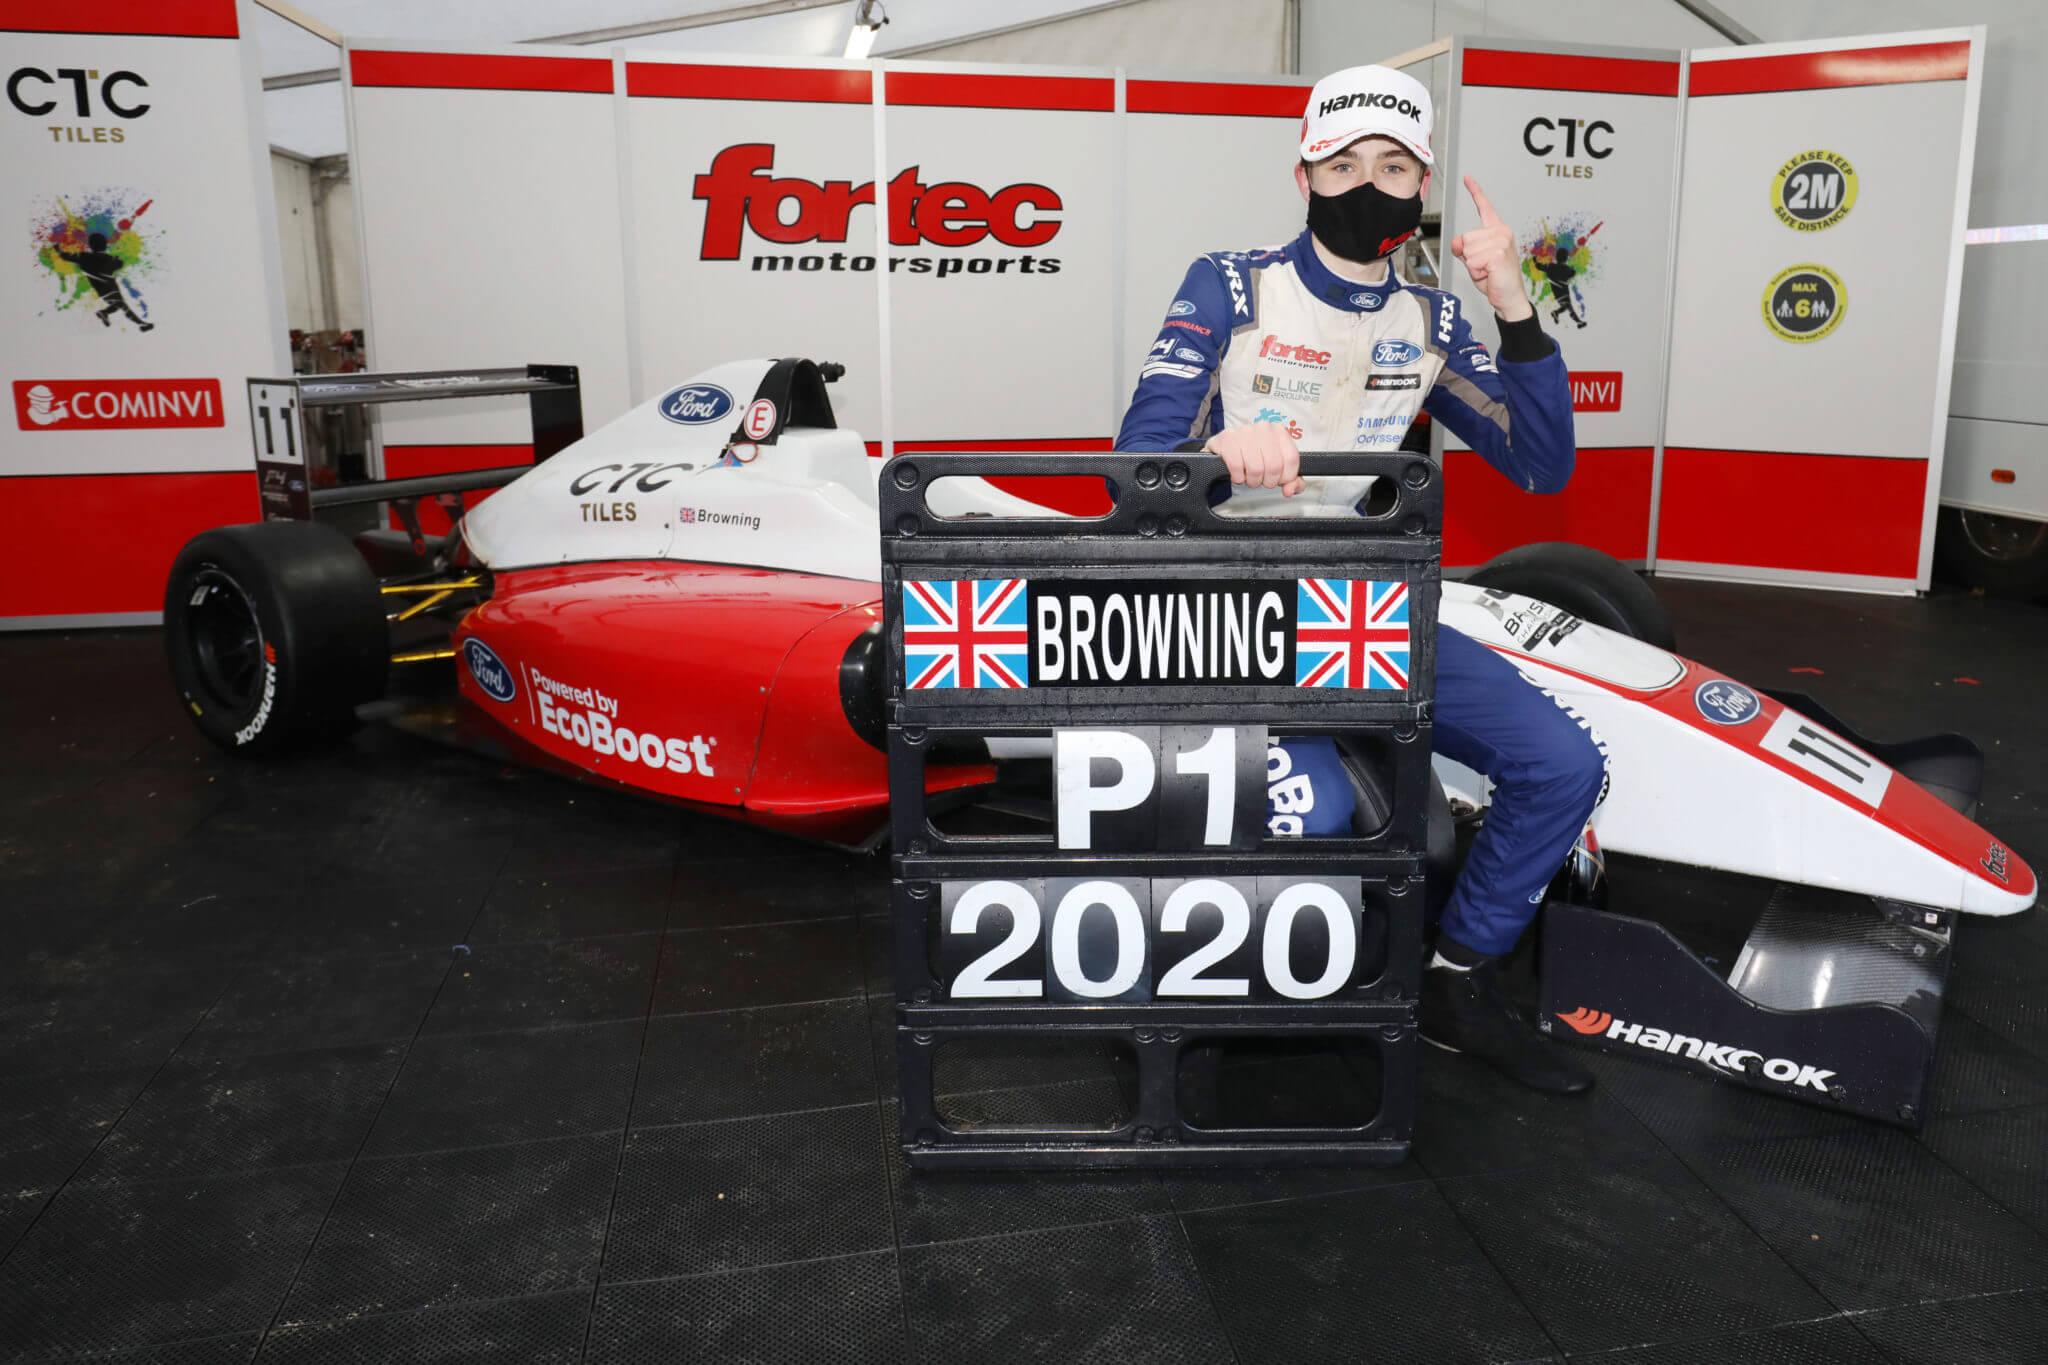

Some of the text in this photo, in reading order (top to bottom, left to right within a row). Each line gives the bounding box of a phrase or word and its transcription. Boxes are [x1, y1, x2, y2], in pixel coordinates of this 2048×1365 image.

[7, 67, 151, 119] CTC
[48, 126, 125, 143] TILES
[1523, 117, 1615, 159] CTC
[1545, 163, 1594, 179] TILES
[1779, 151, 1853, 177] PLEASE KEEP
[692, 143, 1063, 261] fortec
[1788, 173, 1840, 209] 2M
[1775, 206, 1849, 231] SAFE DISTANCE
[751, 252, 1063, 278] motorsports
[1792, 283, 1818, 292] MAX
[1794, 298, 1811, 318] 6
[1259, 334, 1332, 365] fortec
[1267, 356, 1328, 371] motorsports
[1375, 343, 1410, 363] Ford
[1275, 377, 1323, 396] LUKE
[1568, 381, 1616, 404] INVI
[71, 390, 214, 420] COMINVI
[669, 388, 720, 418] Ford
[258, 406, 296, 456] 11
[752, 406, 769, 432] E
[1357, 434, 1402, 446] Odysse
[570, 463, 694, 496] CTC
[580, 502, 637, 522] TILES
[698, 508, 761, 530] Browning
[1037, 591, 1285, 681] BROWNING
[531, 667, 618, 718] Powered by
[1703, 685, 1753, 720] Ford
[536, 690, 715, 777] EcoBoost
[1788, 725, 1871, 784] 11
[950, 879, 1357, 1000] 2020
